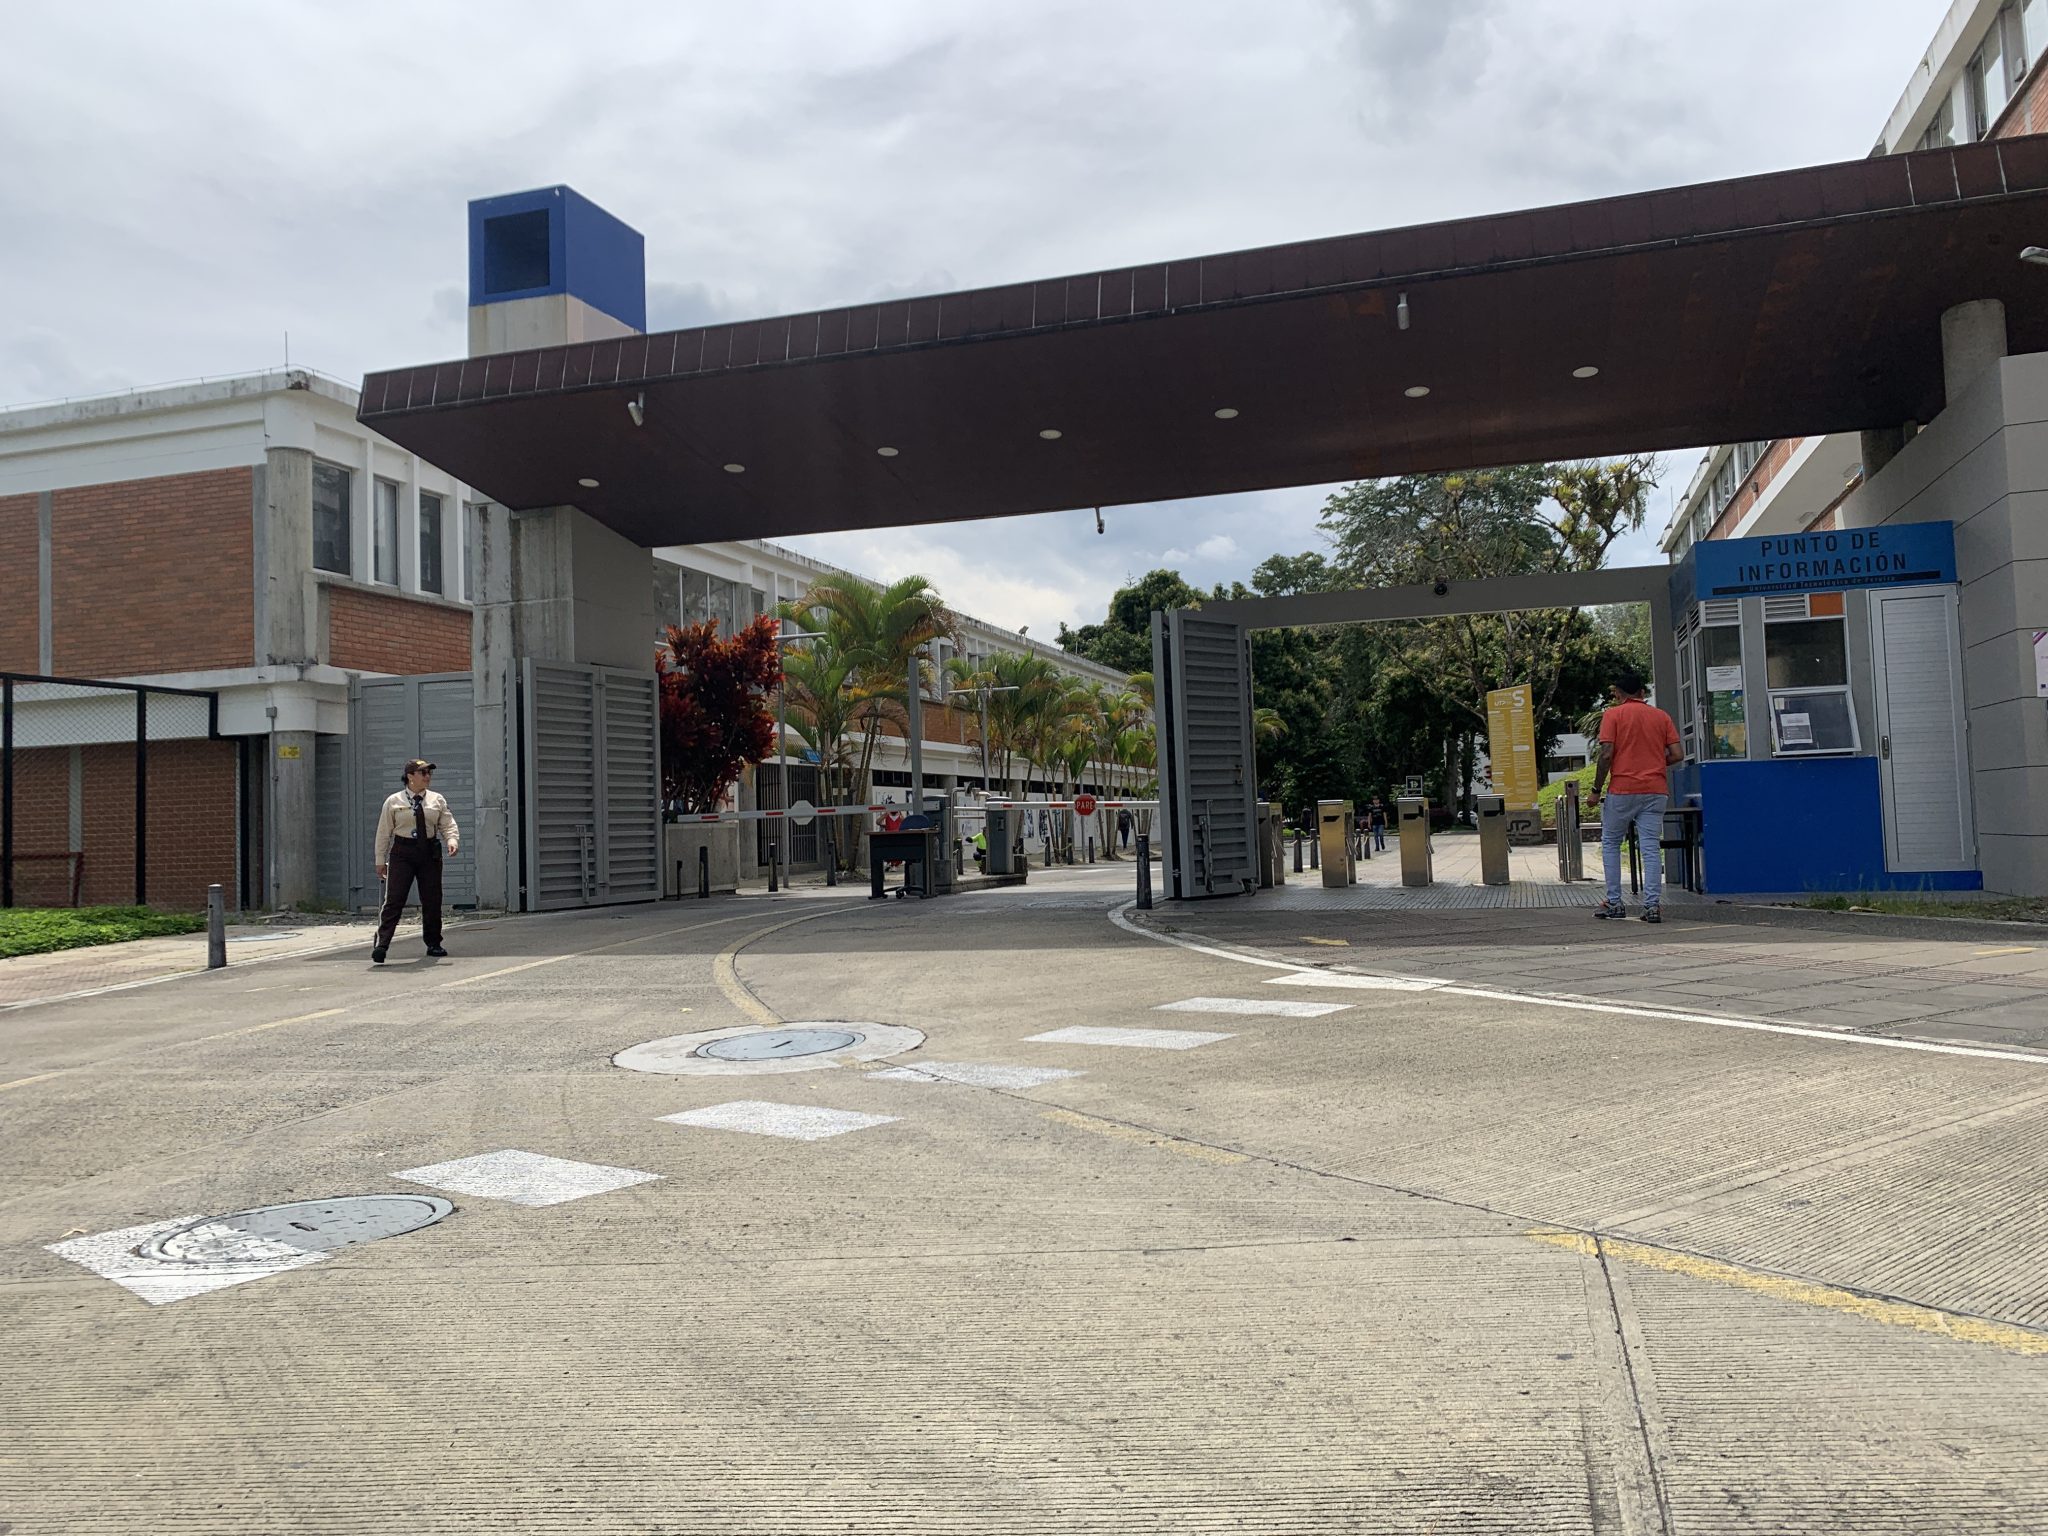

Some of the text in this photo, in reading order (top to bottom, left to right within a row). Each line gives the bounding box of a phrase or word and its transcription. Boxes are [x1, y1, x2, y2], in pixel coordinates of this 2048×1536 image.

[1762, 531, 1880, 557] PUNTO DE
[1738, 550, 1907, 582] INFORMACIÓN
[1076, 800, 1094, 810] PARE
